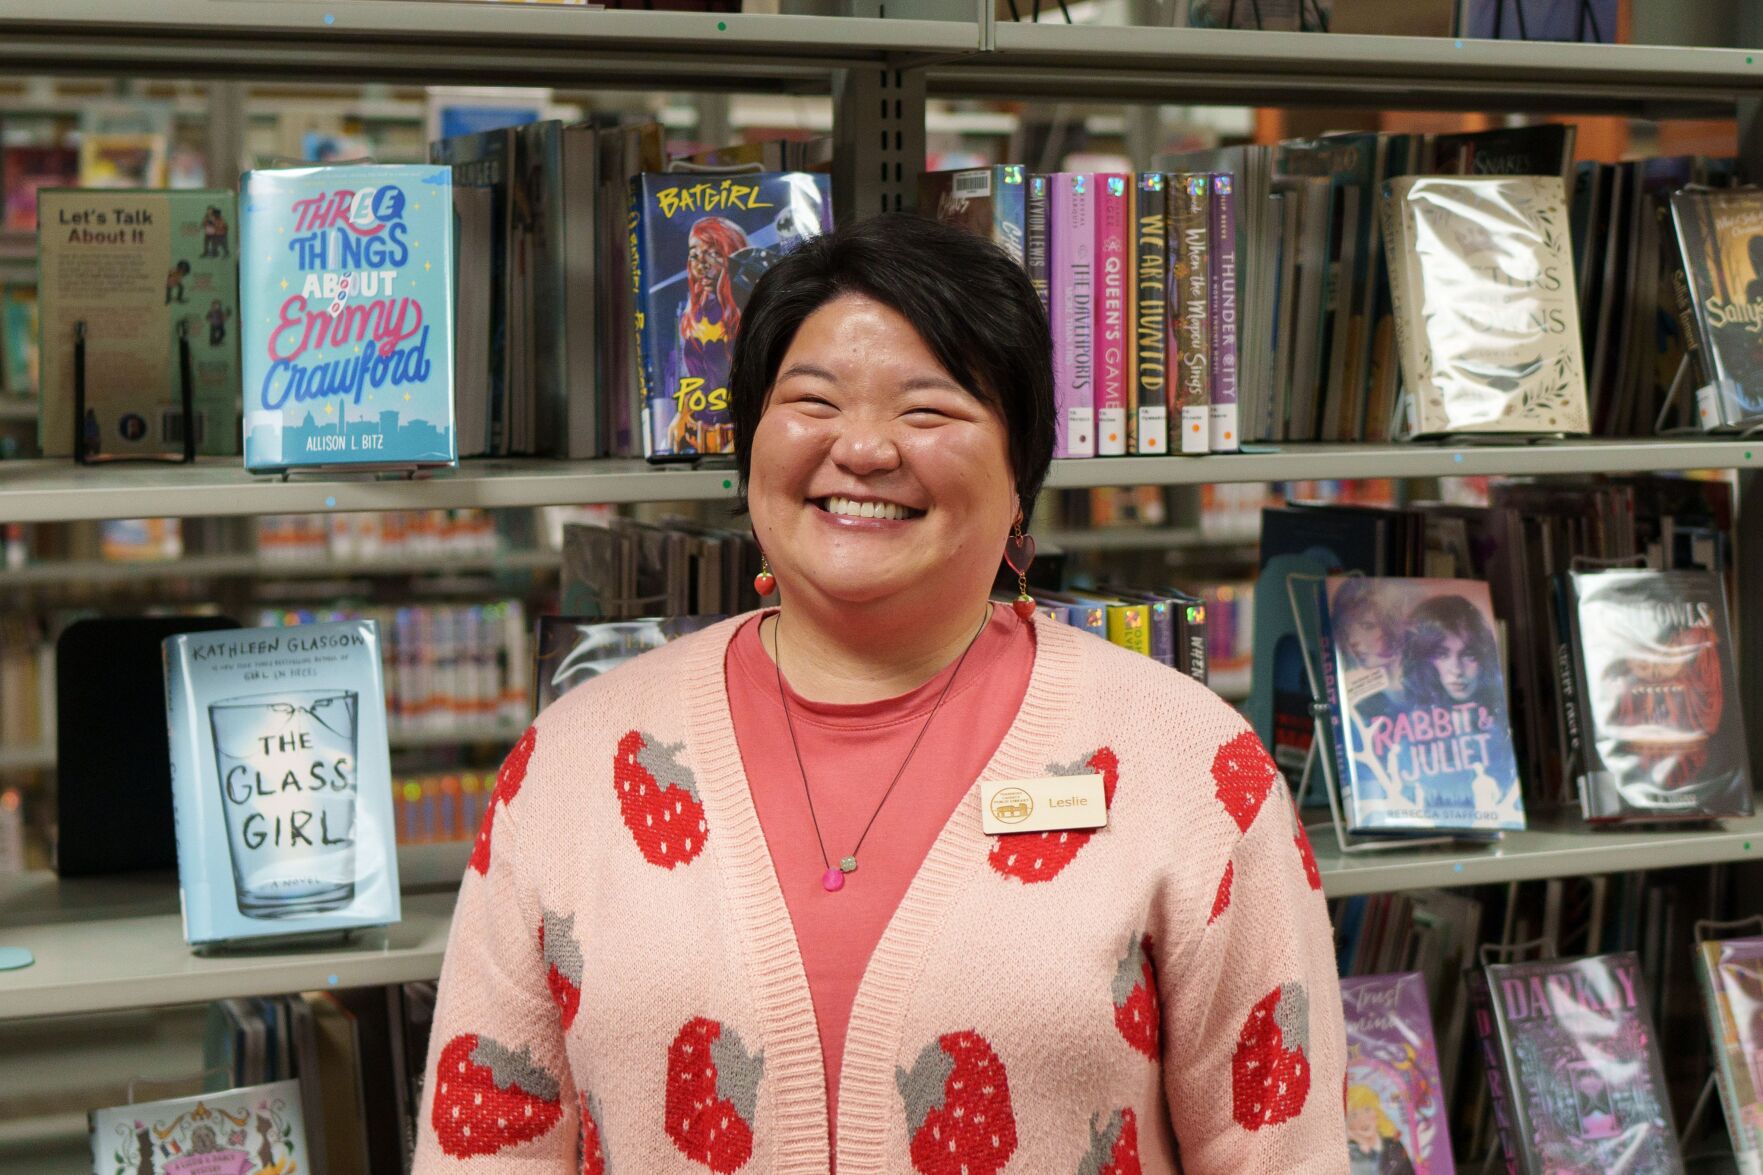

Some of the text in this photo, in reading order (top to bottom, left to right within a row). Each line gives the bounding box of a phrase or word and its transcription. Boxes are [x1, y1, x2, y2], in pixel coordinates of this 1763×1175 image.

[59, 208, 153, 226] Let's Talk
[291, 185, 405, 237] THREE
[656, 180, 774, 218] BATGIRL
[68, 228, 144, 245] About It
[289, 222, 408, 271] THINGS
[1140, 214, 1164, 249] WE
[1185, 228, 1206, 271] When
[301, 271, 398, 298] ABOUT
[1071, 264, 1091, 289] THE
[1140, 255, 1164, 291] ARE
[1190, 275, 1206, 297] the
[1104, 257, 1120, 340] QUEEN'S
[268, 295, 423, 362] Emmy
[1072, 294, 1091, 390] DAVENPORTS
[1138, 299, 1165, 390] HUNTED
[1184, 300, 1206, 348] Mapou
[1222, 251, 1235, 397] THUNDER CITY
[261, 325, 430, 410] Crawford
[1104, 347, 1120, 408] GAME
[1184, 352, 1207, 394] Sings
[306, 436, 345, 451] ALLISON
[362, 434, 384, 449] BITZ
[193, 634, 365, 661] KATHLEEN GLASGOW
[1190, 636, 1205, 680] WHEN
[258, 730, 314, 756] THE
[1370, 701, 1494, 756] RABBIT &
[1402, 734, 1492, 781] JULIET
[226, 758, 349, 805] GLASS
[1049, 796, 1088, 808] Leslie
[243, 810, 350, 850] GIRL
